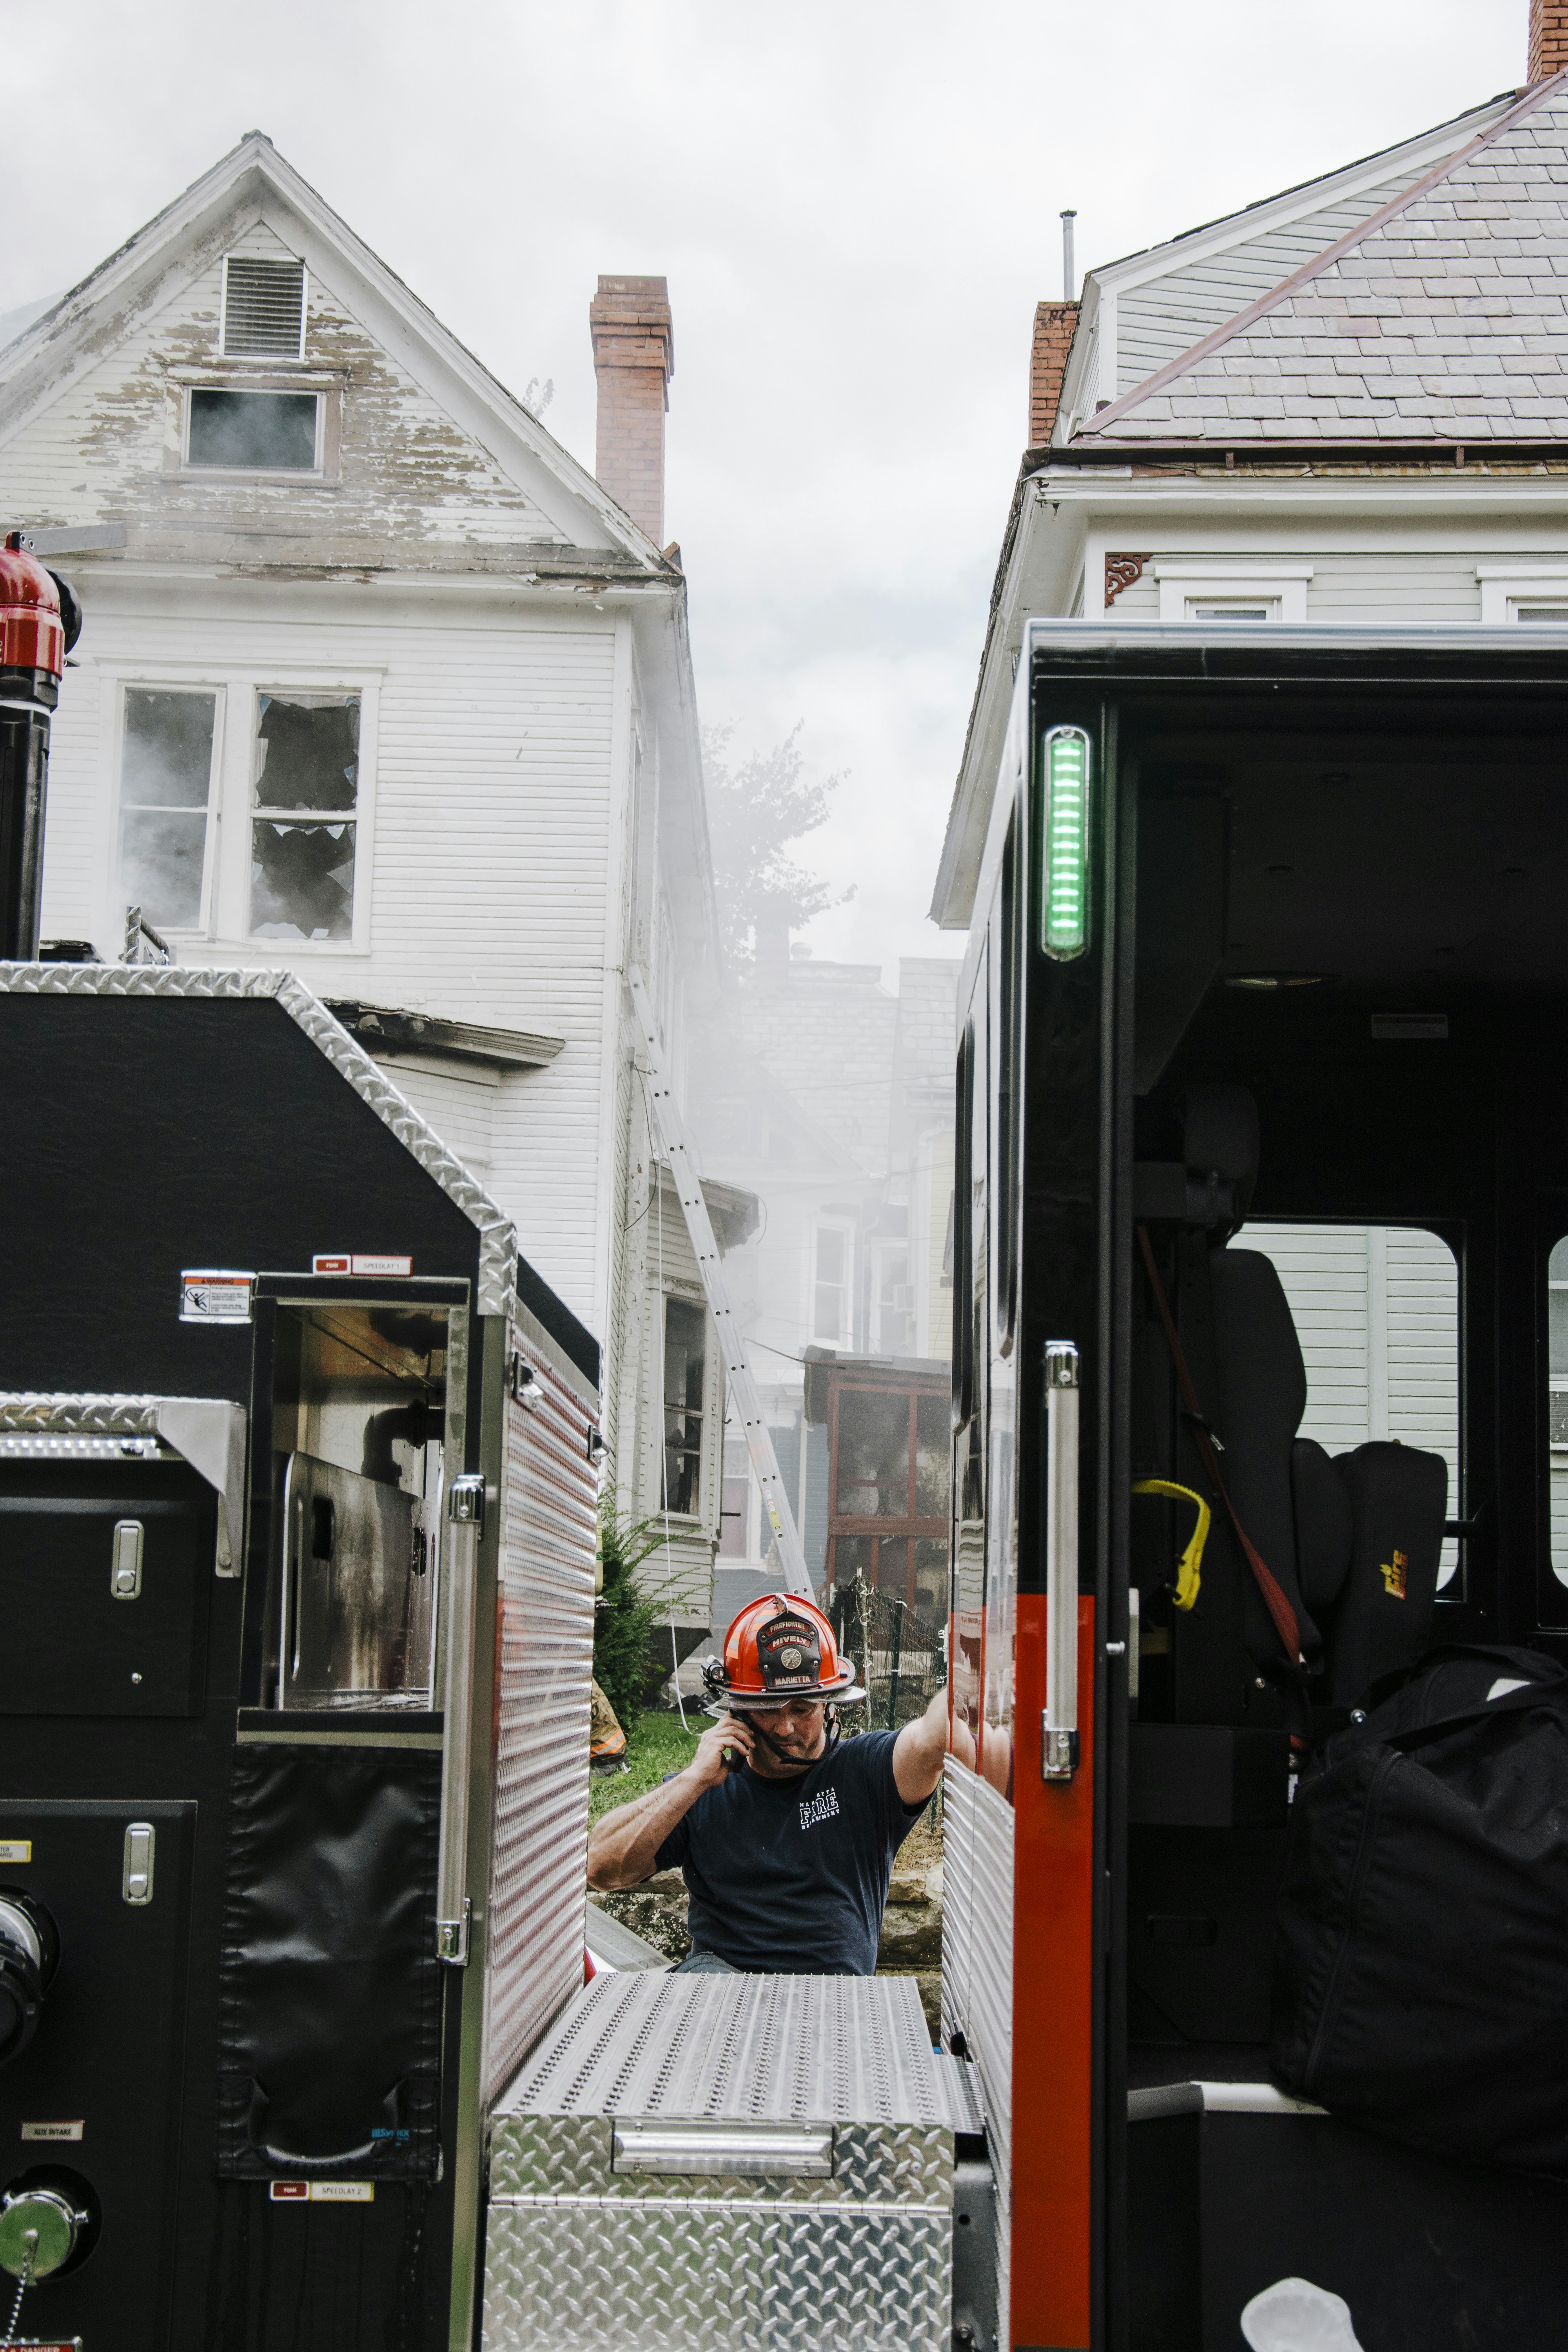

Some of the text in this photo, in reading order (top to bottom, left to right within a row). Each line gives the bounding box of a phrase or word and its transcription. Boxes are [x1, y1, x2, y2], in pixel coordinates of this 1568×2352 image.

[770, 1621, 805, 1633] FIREFIGHTER
[773, 1635, 808, 1648] HIVELY
[775, 1675, 811, 1686] MARIETTA
[800, 1787, 835, 1808] MARETTA
[801, 1809, 840, 1830] DEARTMENT
[49, 2128, 71, 2136] INTAKE
